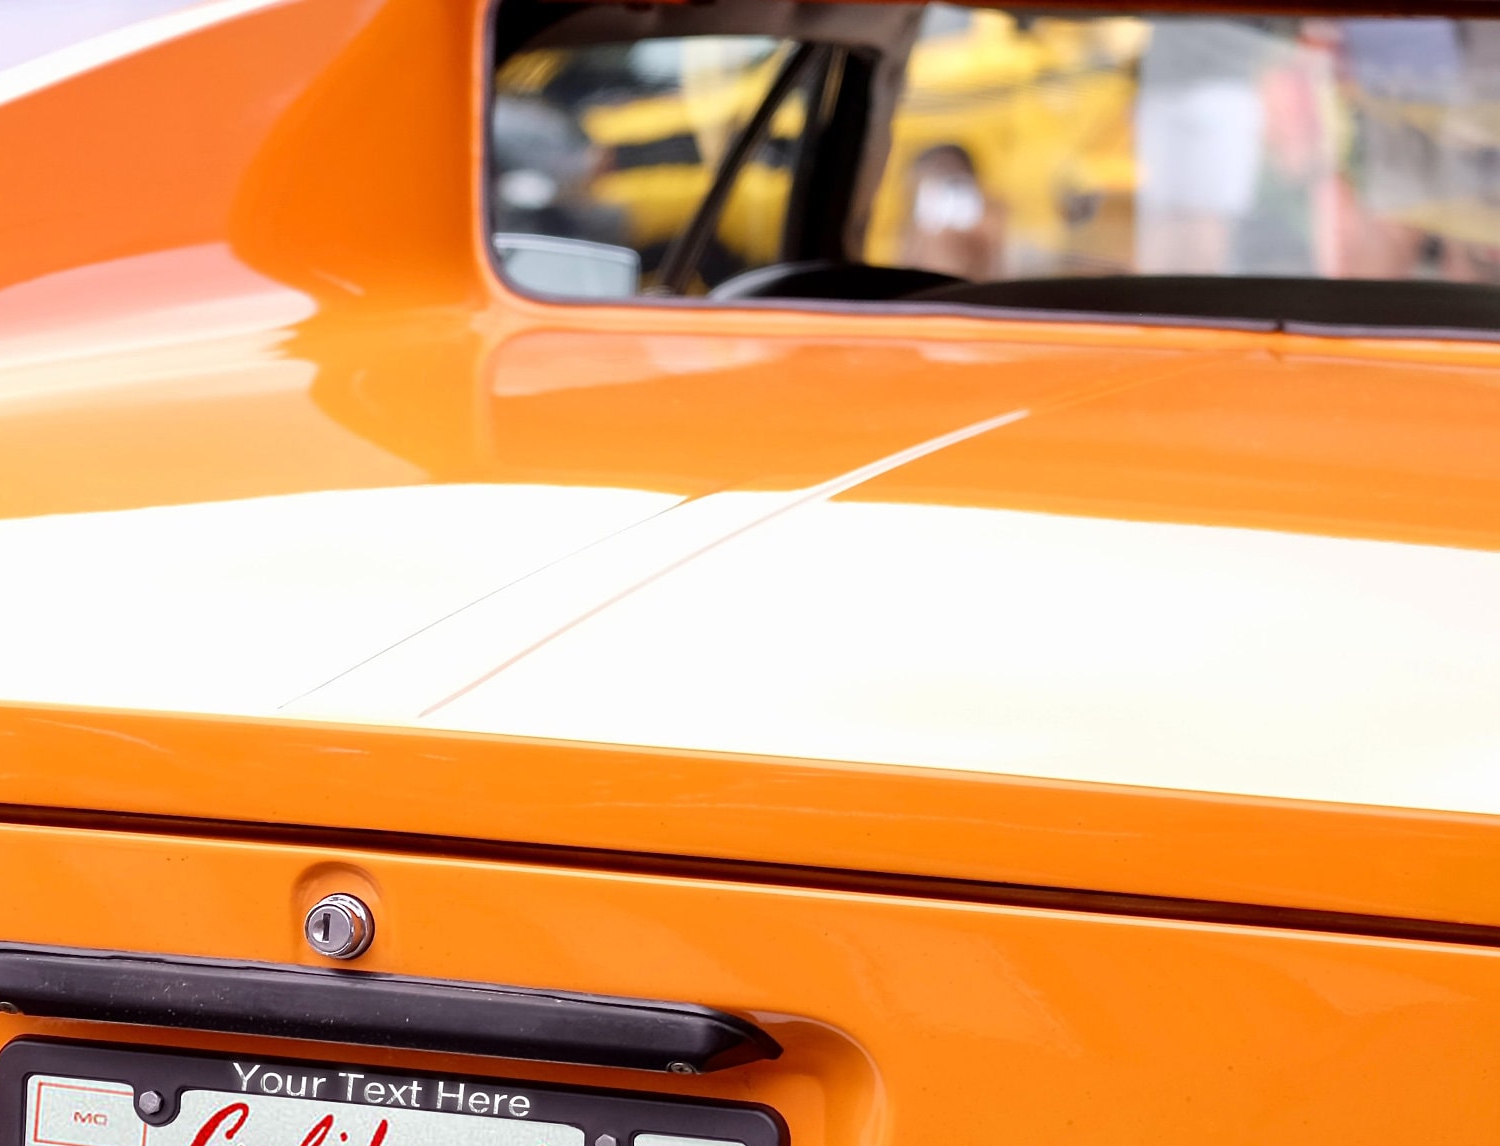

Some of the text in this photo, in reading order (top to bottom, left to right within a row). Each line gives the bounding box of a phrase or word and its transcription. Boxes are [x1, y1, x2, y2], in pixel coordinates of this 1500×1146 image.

[233, 1062, 531, 1117] Your Text Here
